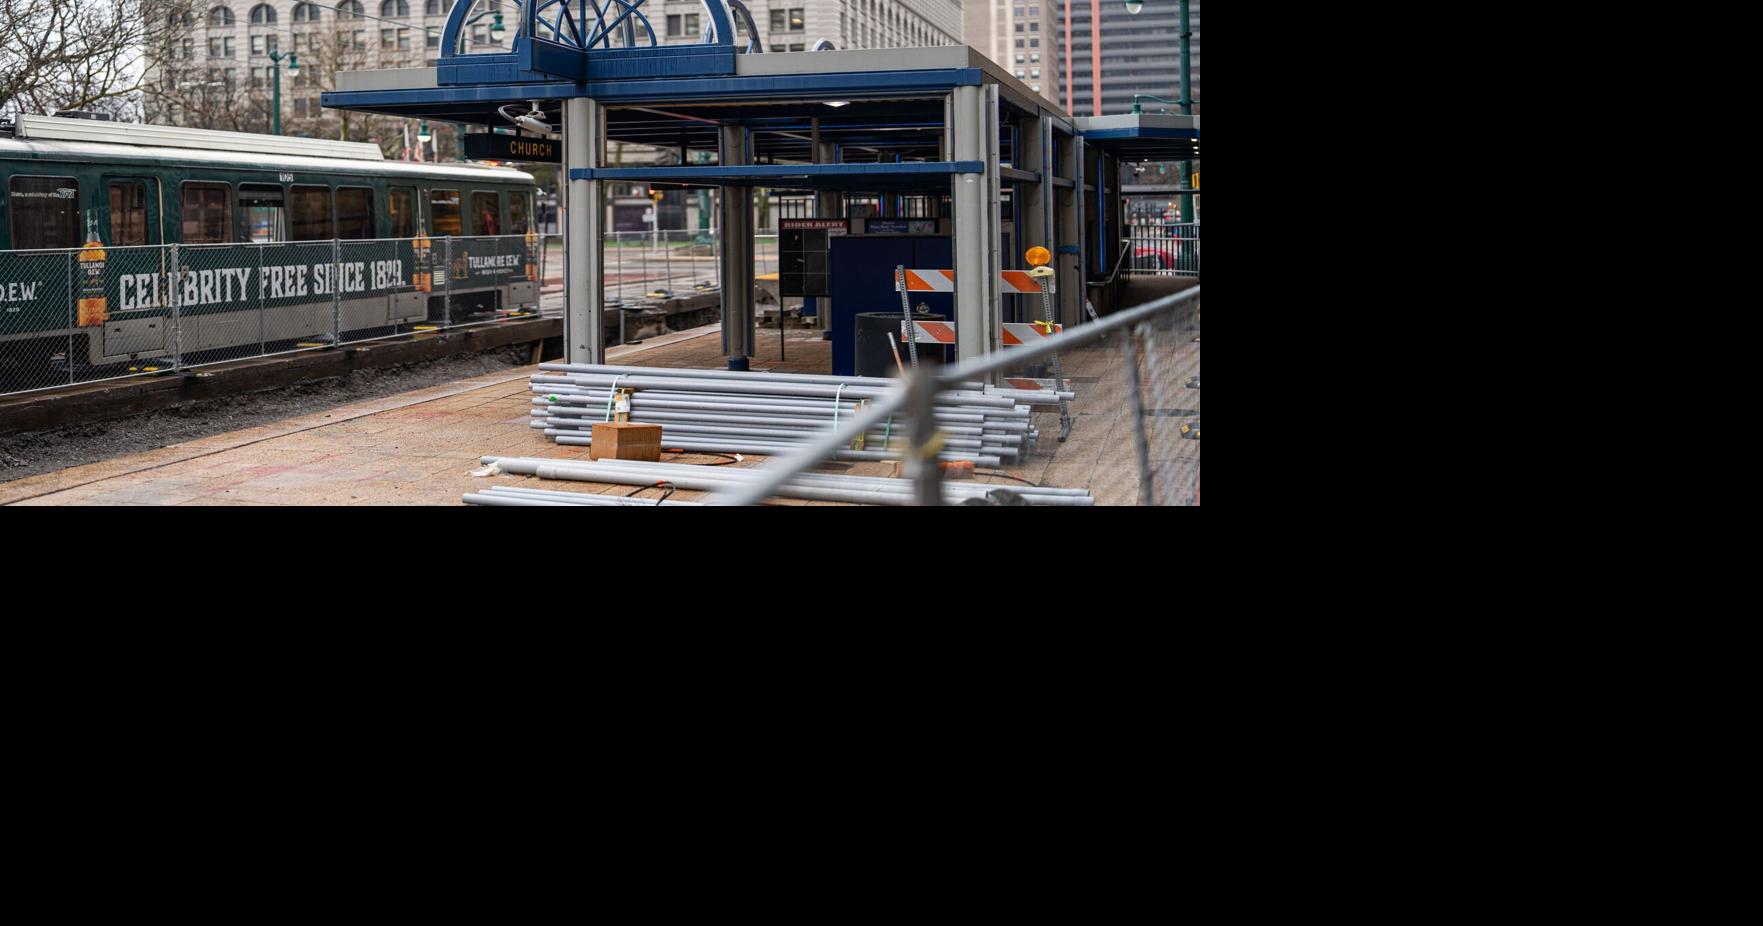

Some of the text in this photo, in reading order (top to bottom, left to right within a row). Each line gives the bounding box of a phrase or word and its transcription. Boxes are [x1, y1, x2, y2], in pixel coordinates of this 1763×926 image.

[510, 140, 552, 157] CHURCH
[259, 264, 308, 299] FREE
[313, 261, 365, 294] SINCE
